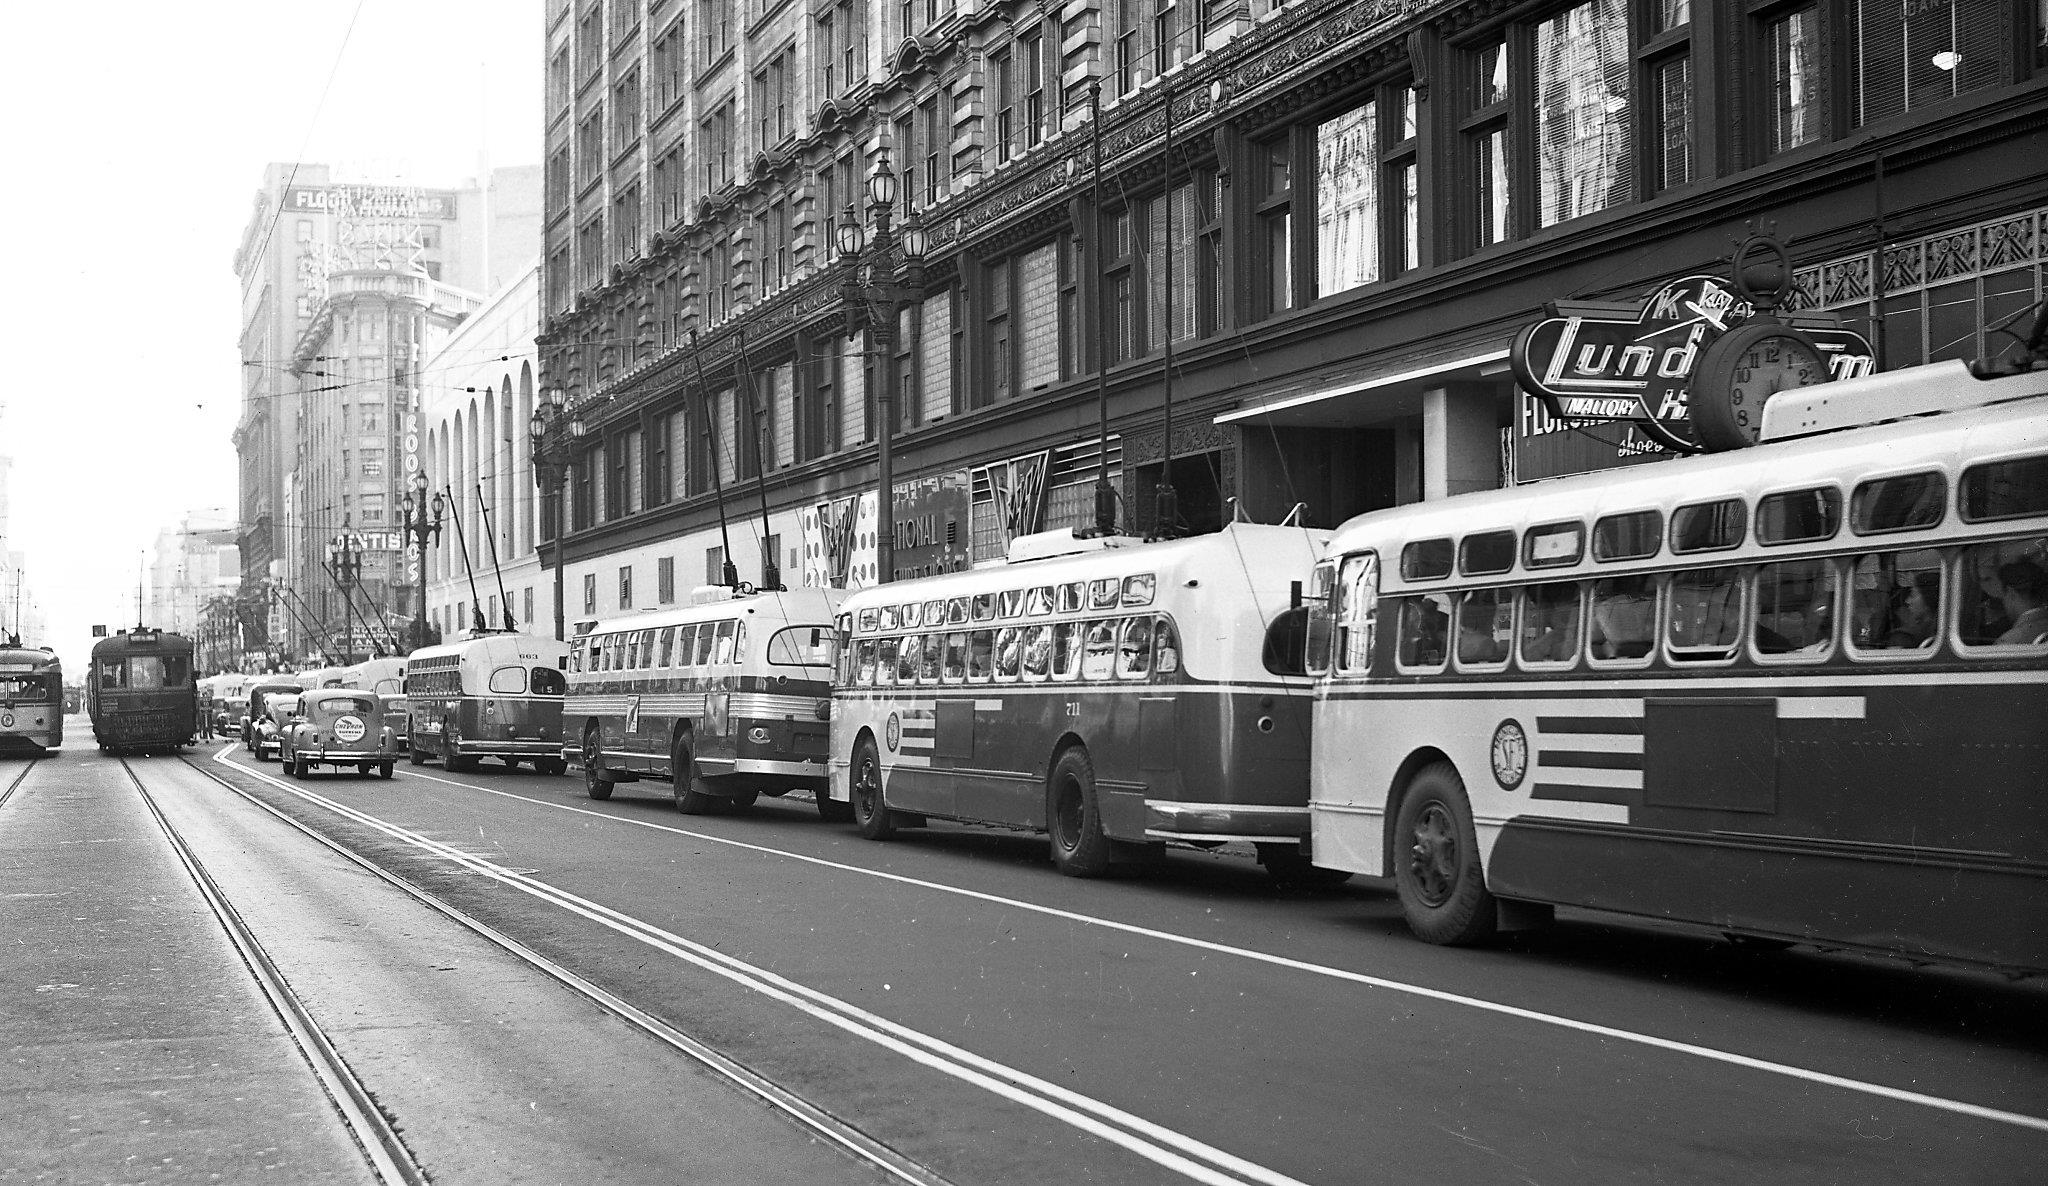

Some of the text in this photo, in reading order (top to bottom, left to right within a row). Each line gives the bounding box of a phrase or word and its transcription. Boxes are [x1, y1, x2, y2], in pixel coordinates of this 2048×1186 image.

[1750, 353, 1760, 368] 11
[1765, 348, 1780, 363] 12
[1736, 367, 1751, 383] 10
[1799, 369, 1808, 385] 2
[1733, 388, 1743, 405] 9
[1568, 398, 1638, 416] MALLORY
[1737, 410, 1748, 426] 8
[1618, 427, 1664, 457] shoes
[405, 414, 419, 493] ROOS
[893, 515, 940, 550] TIONAL
[352, 626, 385, 634] NGLO
[1066, 702, 1080, 716] 711
